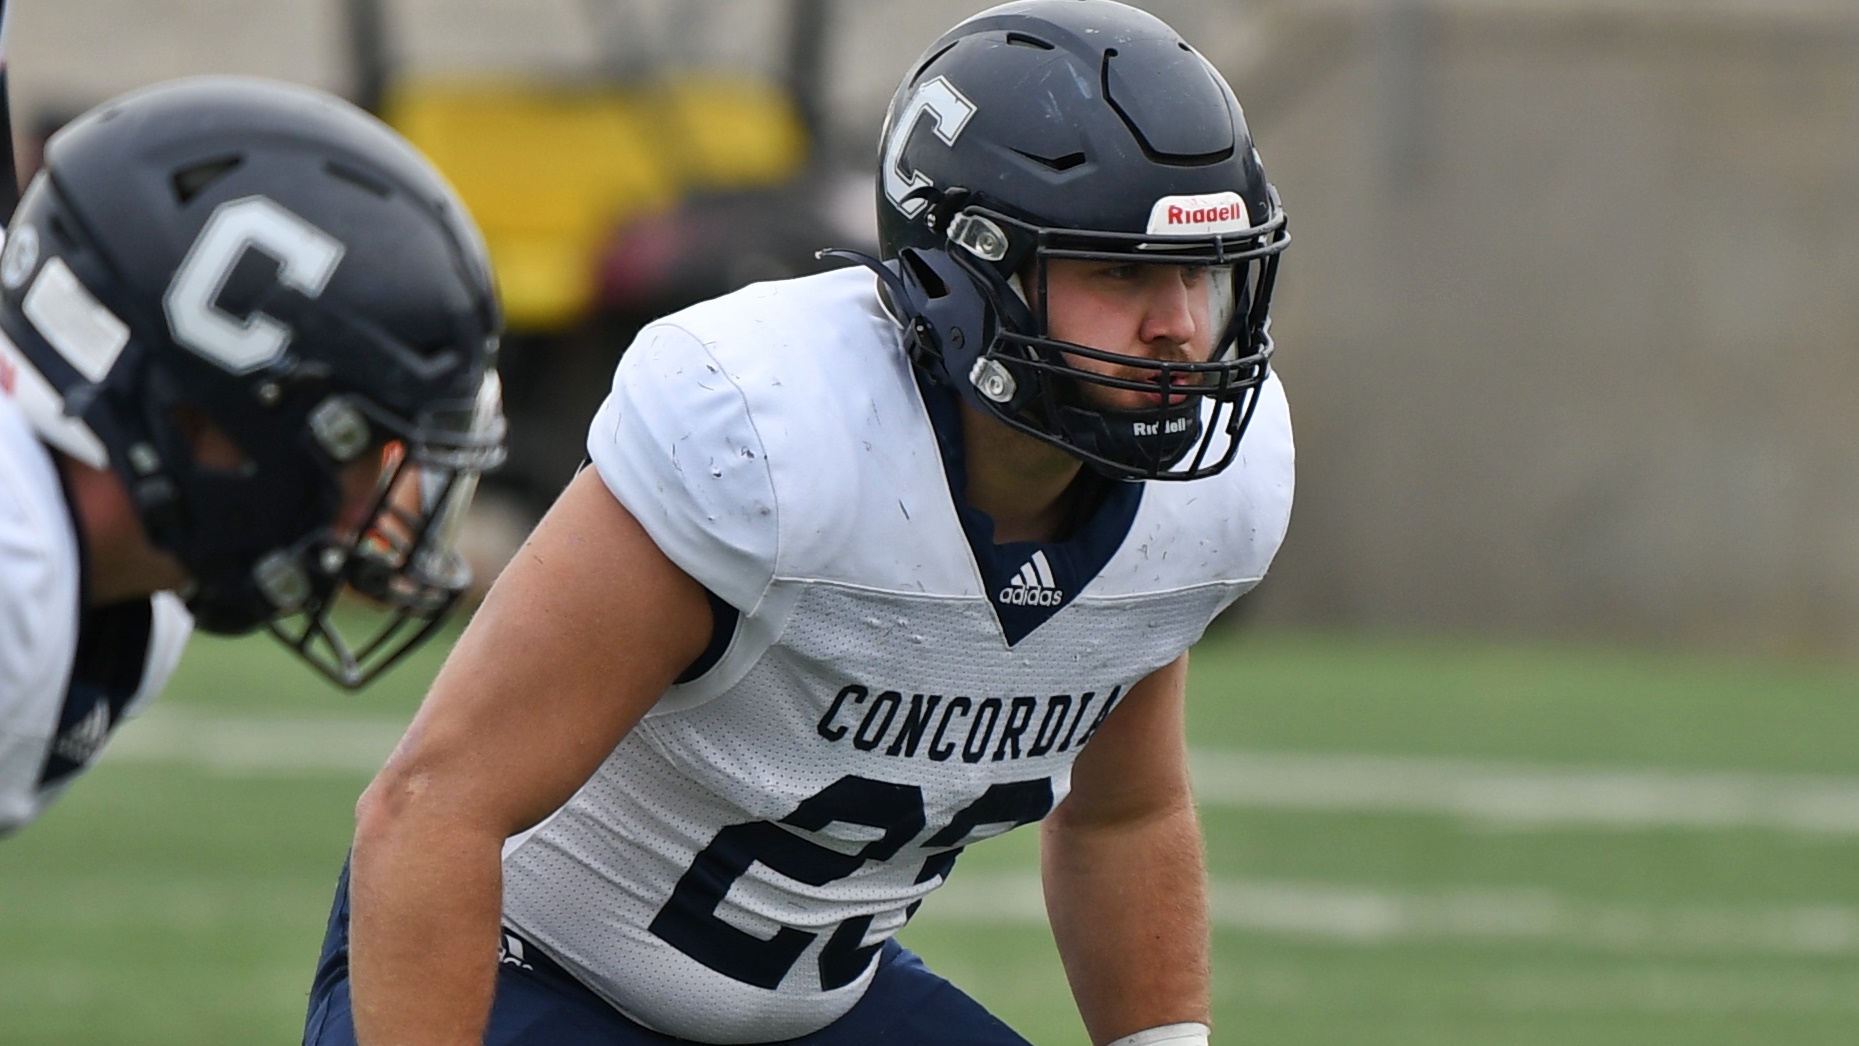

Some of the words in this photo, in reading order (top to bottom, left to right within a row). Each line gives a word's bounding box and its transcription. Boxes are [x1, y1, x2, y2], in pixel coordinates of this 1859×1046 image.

[882, 75, 978, 219] C
[1167, 203, 1241, 224] Riddell
[163, 194, 346, 375] C
[999, 585, 1063, 607] adidas
